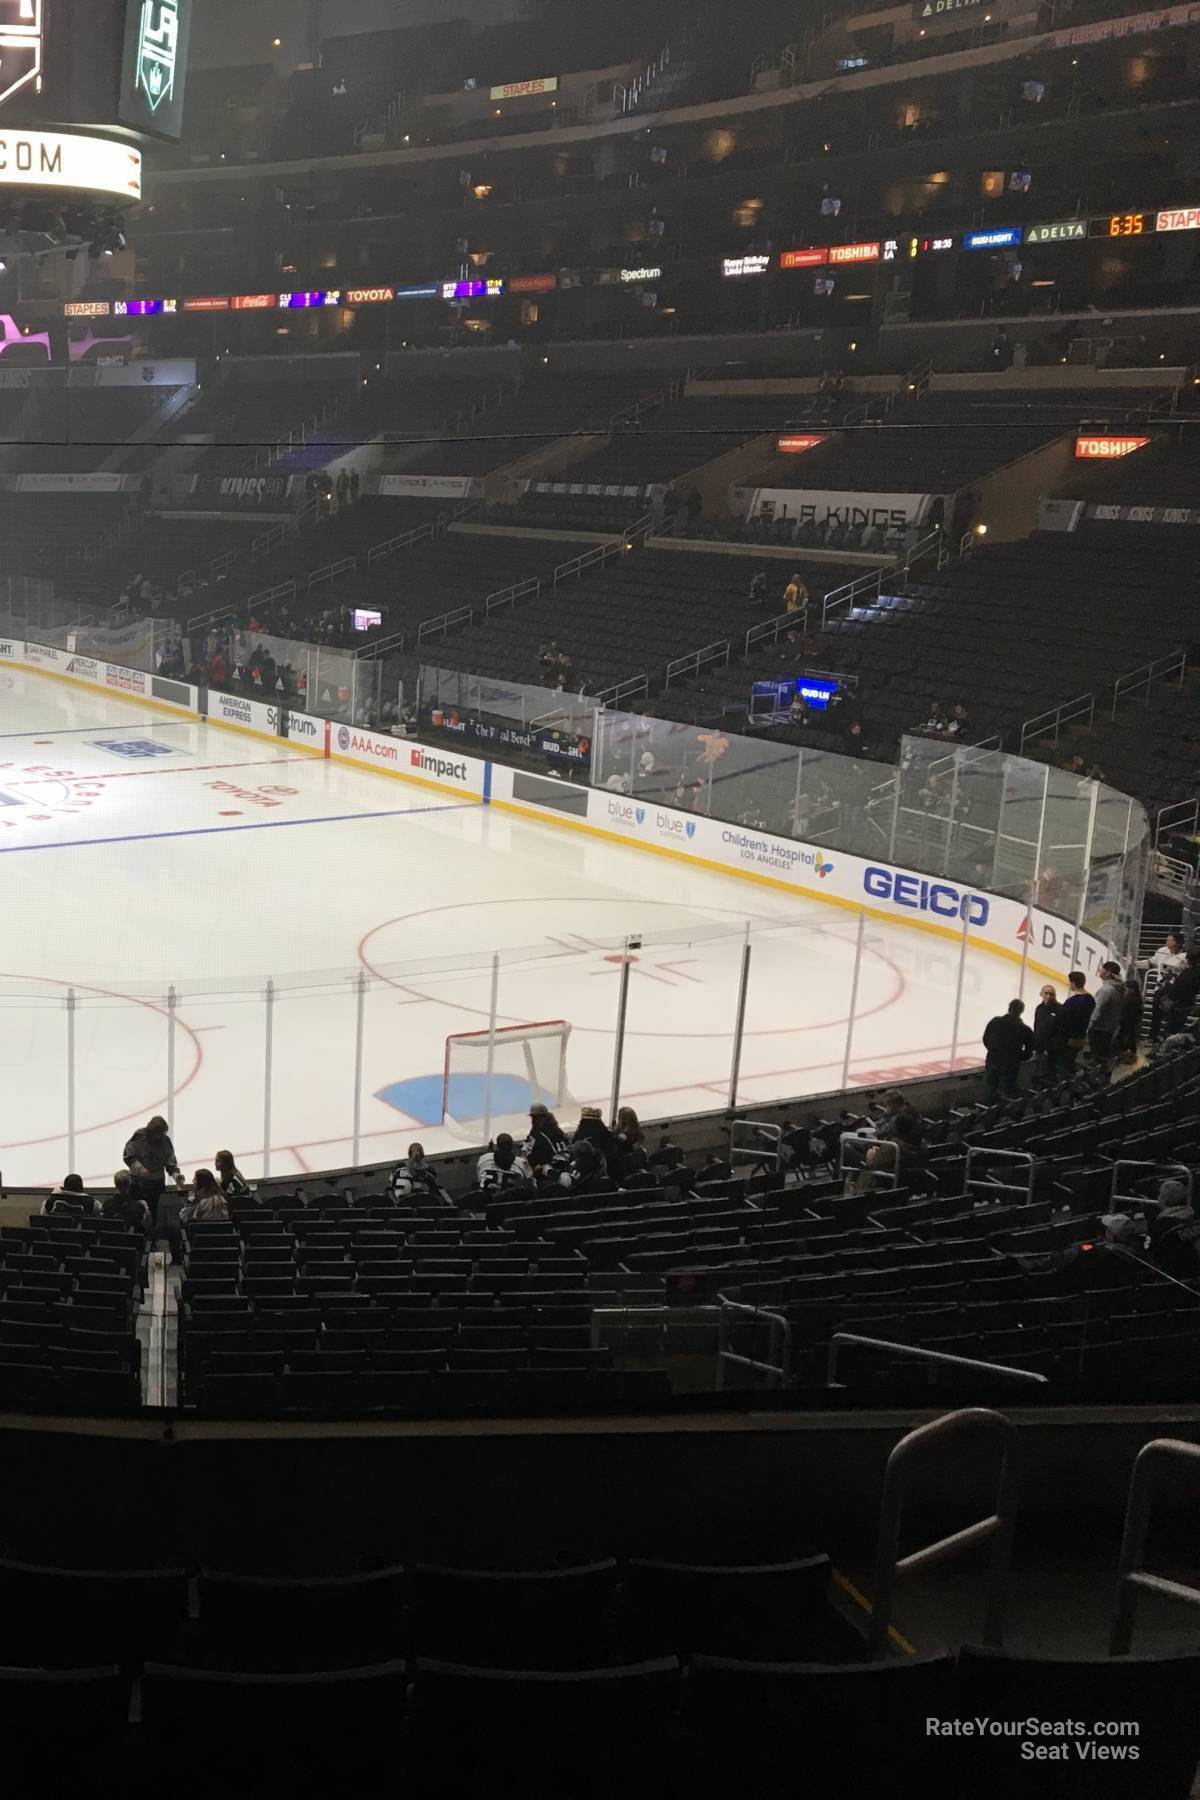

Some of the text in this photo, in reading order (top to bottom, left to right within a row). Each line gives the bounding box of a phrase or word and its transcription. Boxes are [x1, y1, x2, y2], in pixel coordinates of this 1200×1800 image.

[503, 81, 545, 97] STAPLES
[1040, 225, 1084, 240] DELTA
[1110, 214, 1144, 237] 6:35
[885, 240, 898, 250] STL
[971, 233, 1013, 246] BUD LIGHT
[831, 245, 879, 261] TOSHIBA
[883, 250, 894, 260] LA
[620, 267, 662, 283] Spectrum
[348, 288, 393, 302] TOYOTA
[65, 304, 109, 316] STAPLES
[783, 503, 907, 529] LA KINGS
[801, 687, 818, 698] BUD
[219, 696, 252, 712] AMERICAN
[223, 706, 252, 722] EXPRESS
[475, 724, 488, 737] The
[351, 735, 398, 760] AAA.com
[542, 740, 560, 752] BUD
[420, 739, 467, 780] impact
[202, 780, 284, 807] TOYOTA
[608, 800, 633, 820] blue
[656, 812, 683, 833] blue
[722, 831, 815, 866] Children's Hospital
[741, 851, 793, 871] LOS ANGELES
[864, 866, 990, 926] GEICO
[1042, 924, 1107, 978] DELTA
